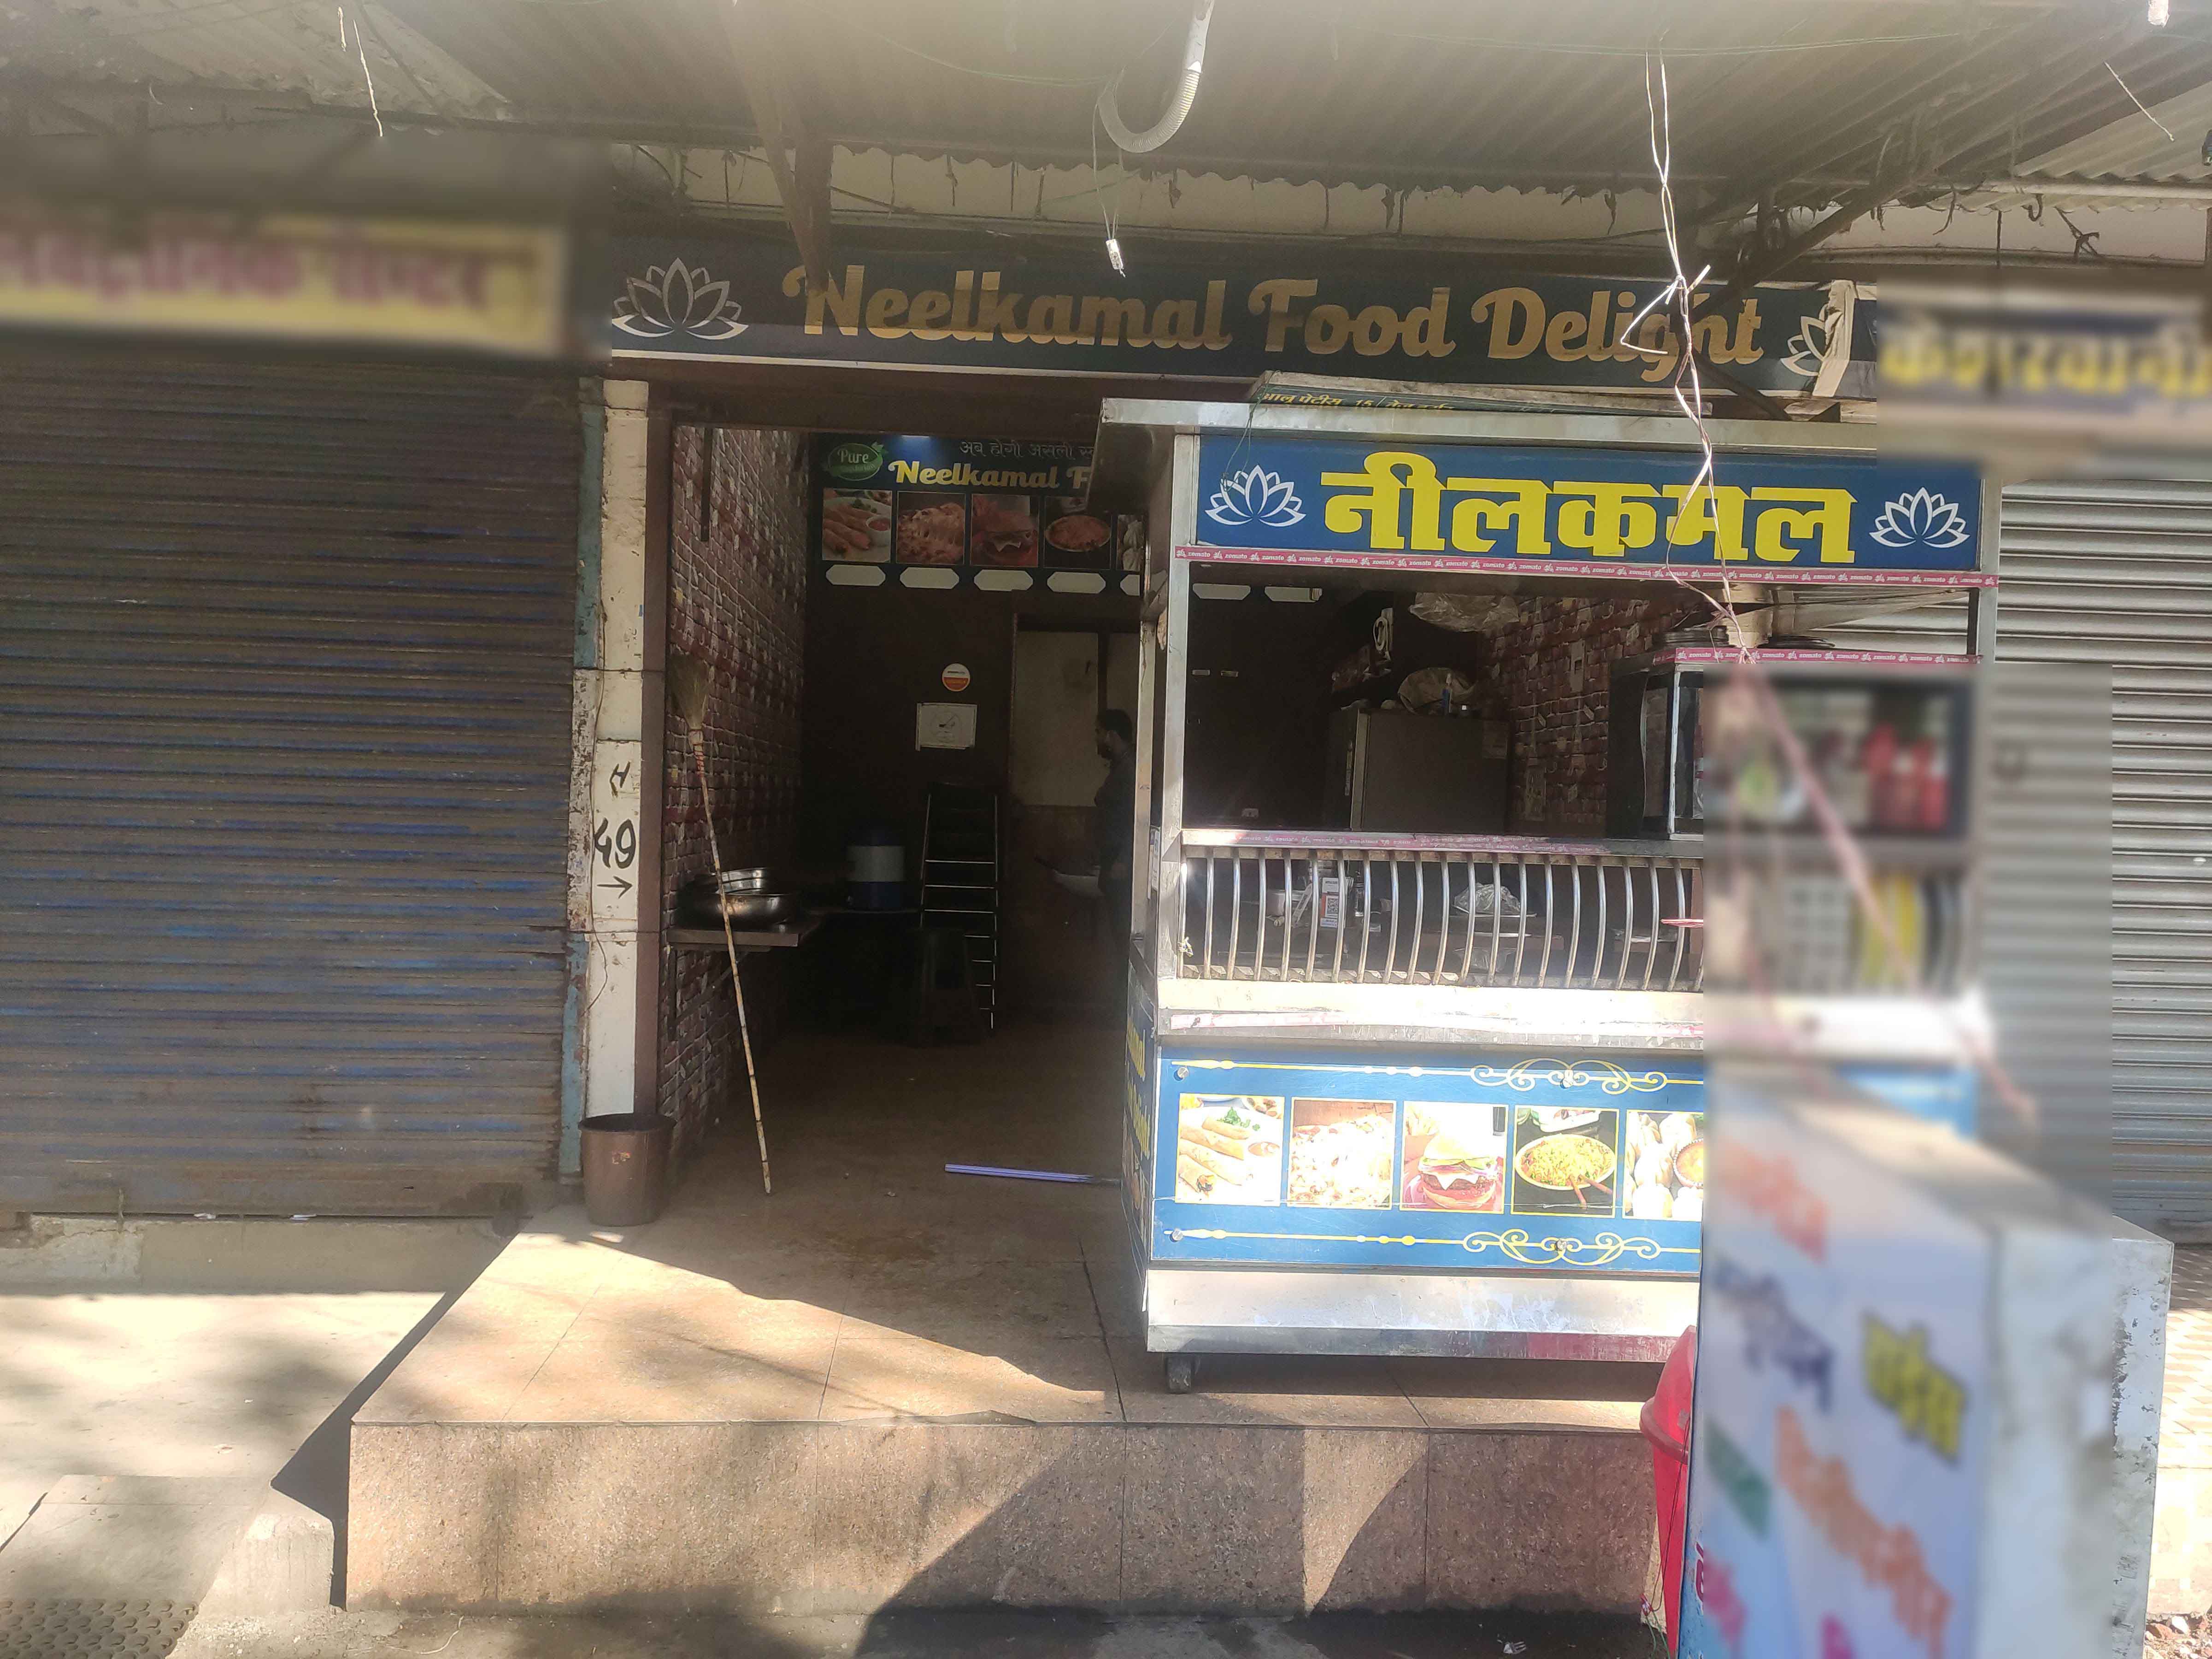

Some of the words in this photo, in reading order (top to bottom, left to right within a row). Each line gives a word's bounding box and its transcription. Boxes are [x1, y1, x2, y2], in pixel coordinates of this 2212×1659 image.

[782, 264, 1233, 351] Neelkamal
[1248, 278, 1457, 359] Food
[1471, 286, 1765, 382] Delight
[837, 449, 869, 464] Pure
[959, 440, 986, 457] अब
[989, 439, 1024, 458] होगी
[888, 460, 1059, 488] Neelkamal
[1321, 451, 1858, 563] नीलकमल
[594, 817, 636, 870] 49
